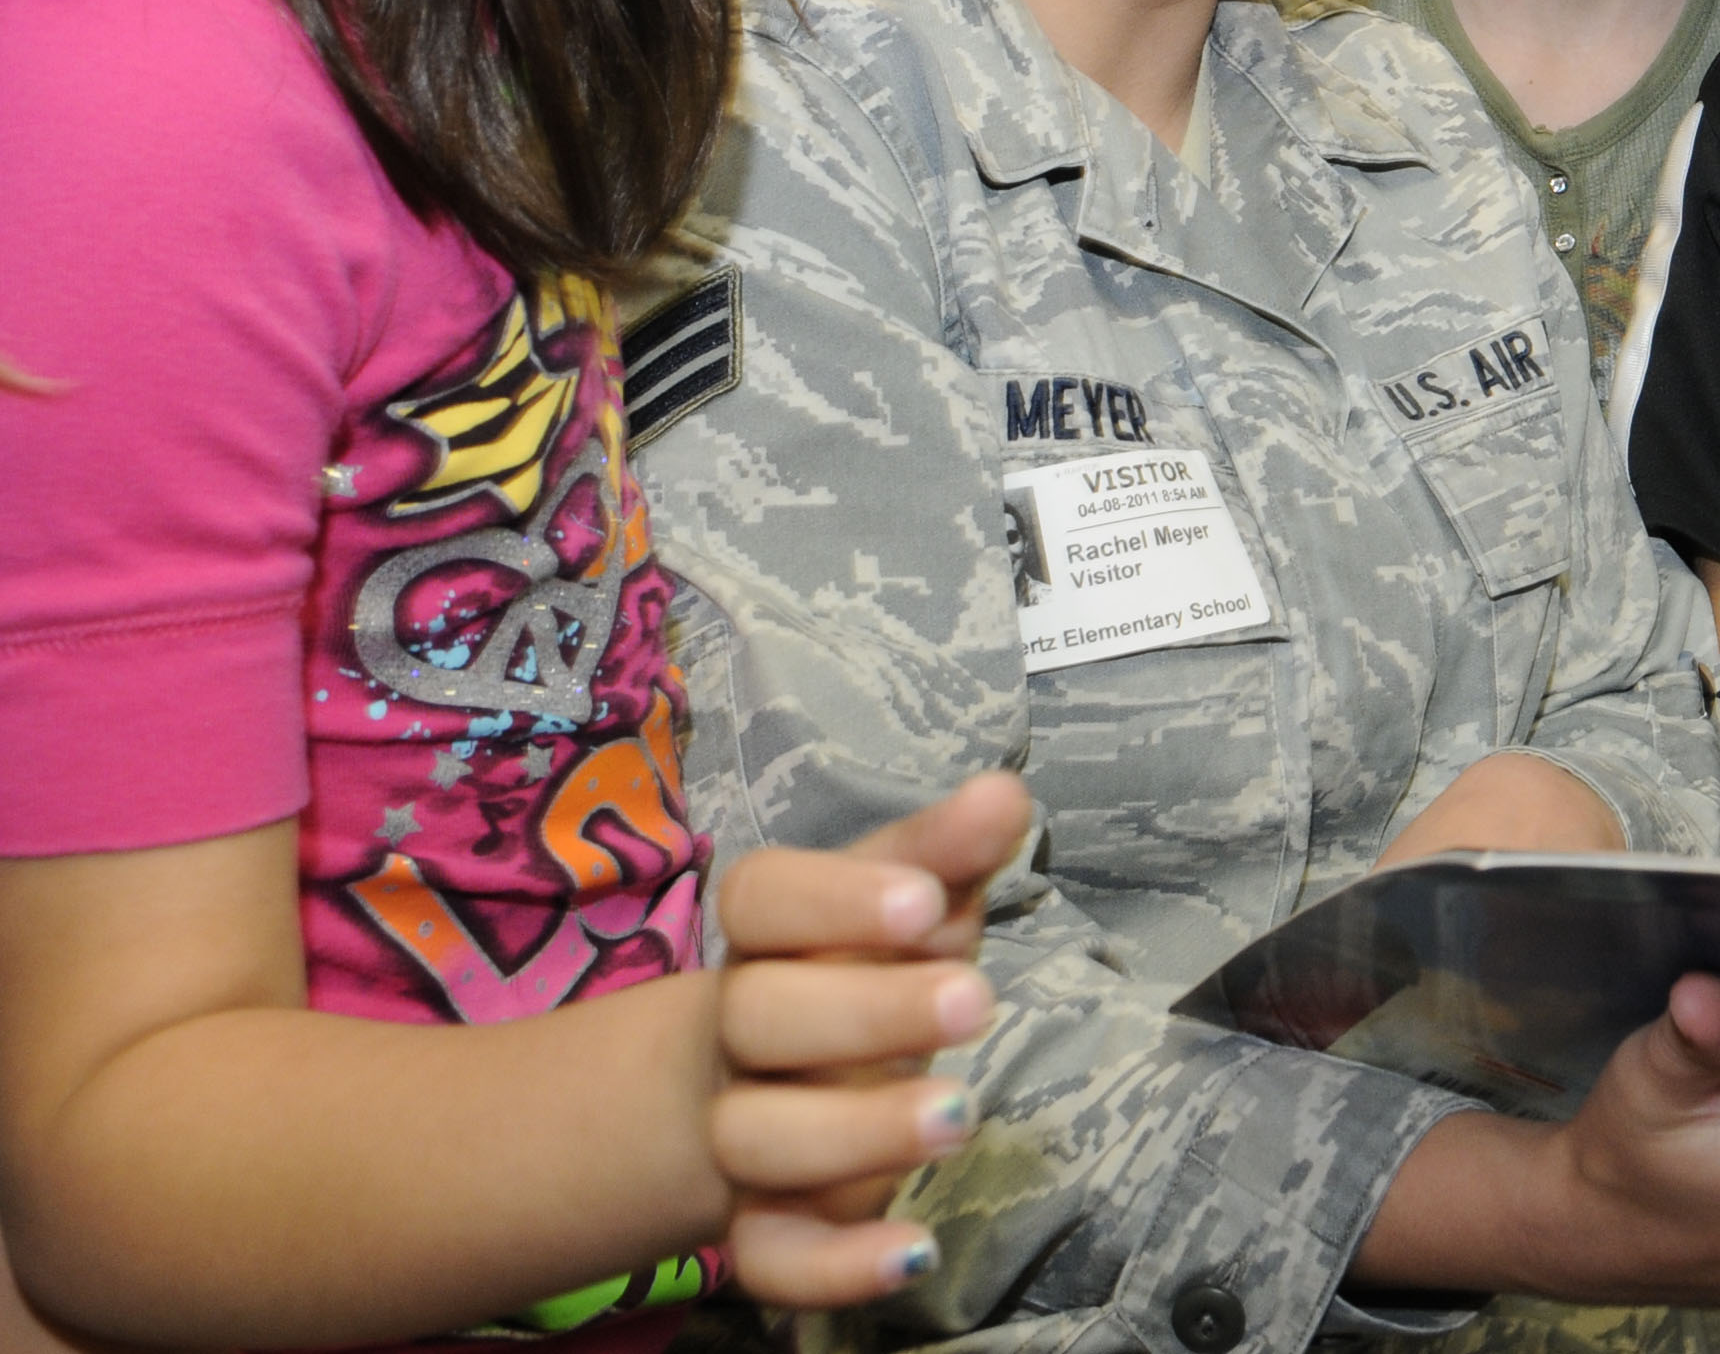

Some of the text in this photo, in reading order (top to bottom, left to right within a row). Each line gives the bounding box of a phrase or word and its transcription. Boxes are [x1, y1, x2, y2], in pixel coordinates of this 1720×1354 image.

[1382, 330, 1545, 422] U.S. AIR
[1004, 377, 1155, 445] MEYER
[1083, 460, 1193, 494] VISITOR
[1077, 492, 1159, 519] 04-08-2011
[1190, 486, 1208, 499] AM
[1066, 524, 1210, 565] Rachel Meyer
[1069, 560, 1143, 590] Visitor
[1063, 608, 1184, 649] Elementary
[1189, 593, 1252, 622] School
